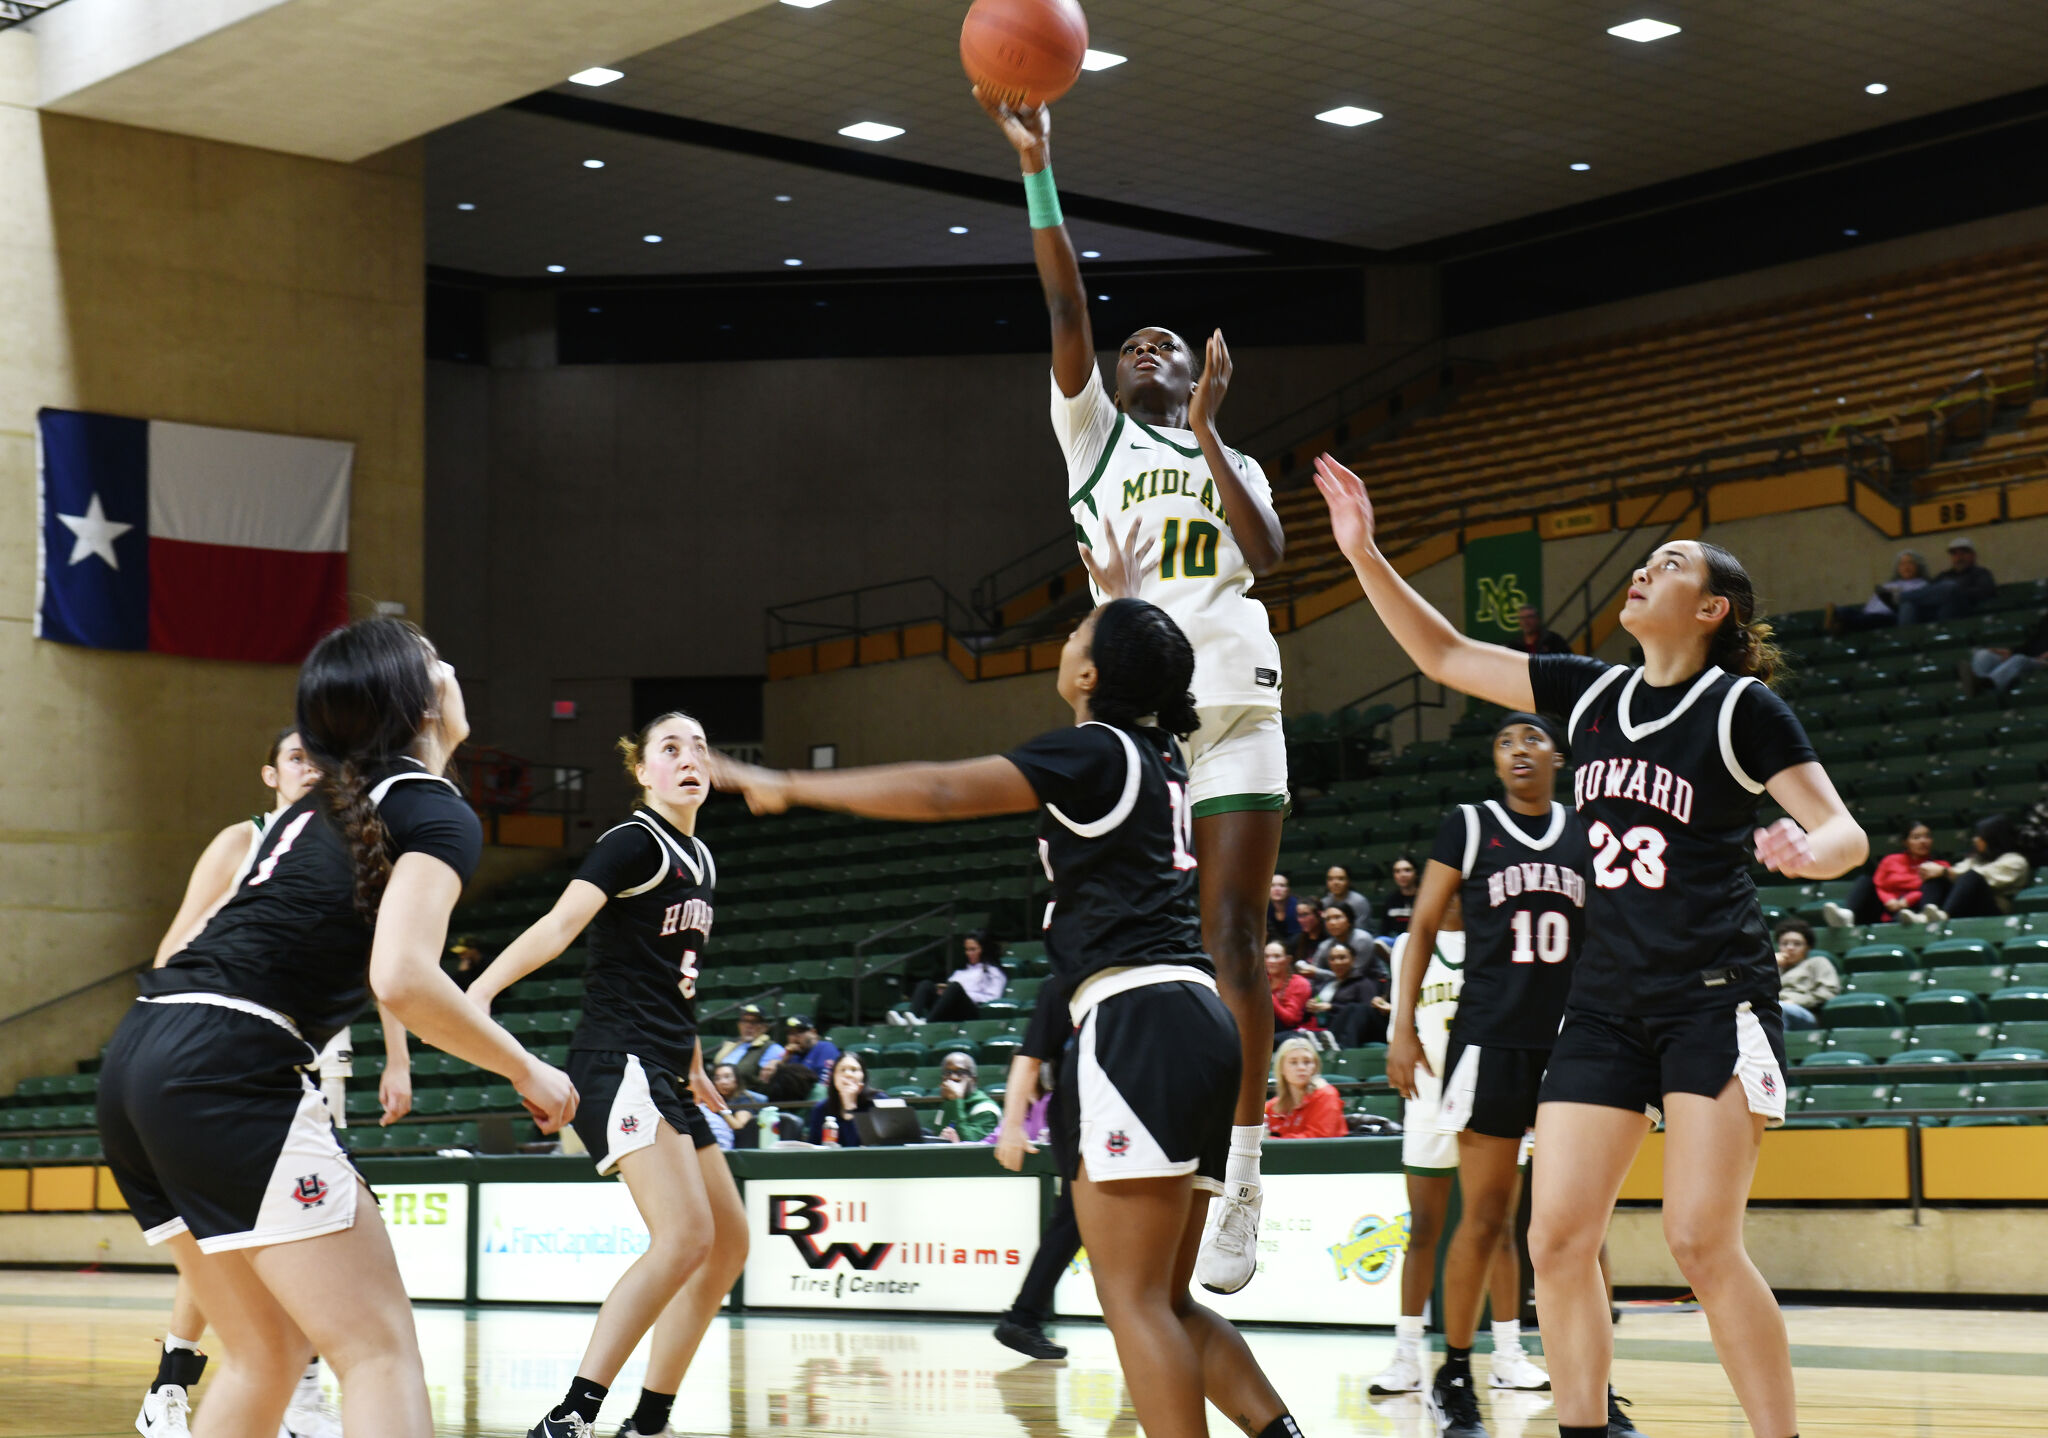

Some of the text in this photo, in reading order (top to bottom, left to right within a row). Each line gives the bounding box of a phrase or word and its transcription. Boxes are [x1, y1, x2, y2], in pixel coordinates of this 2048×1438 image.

[1159, 517, 1221, 581] 10
[1574, 757, 1694, 825] HOWARD
[1588, 820, 1669, 889] 23
[1487, 862, 1586, 908] HOWARD
[1510, 909, 1570, 964] 10
[768, 1195, 867, 1236] Bill
[790, 1236, 1021, 1271] Williams
[790, 1275, 920, 1295] Tire Center
